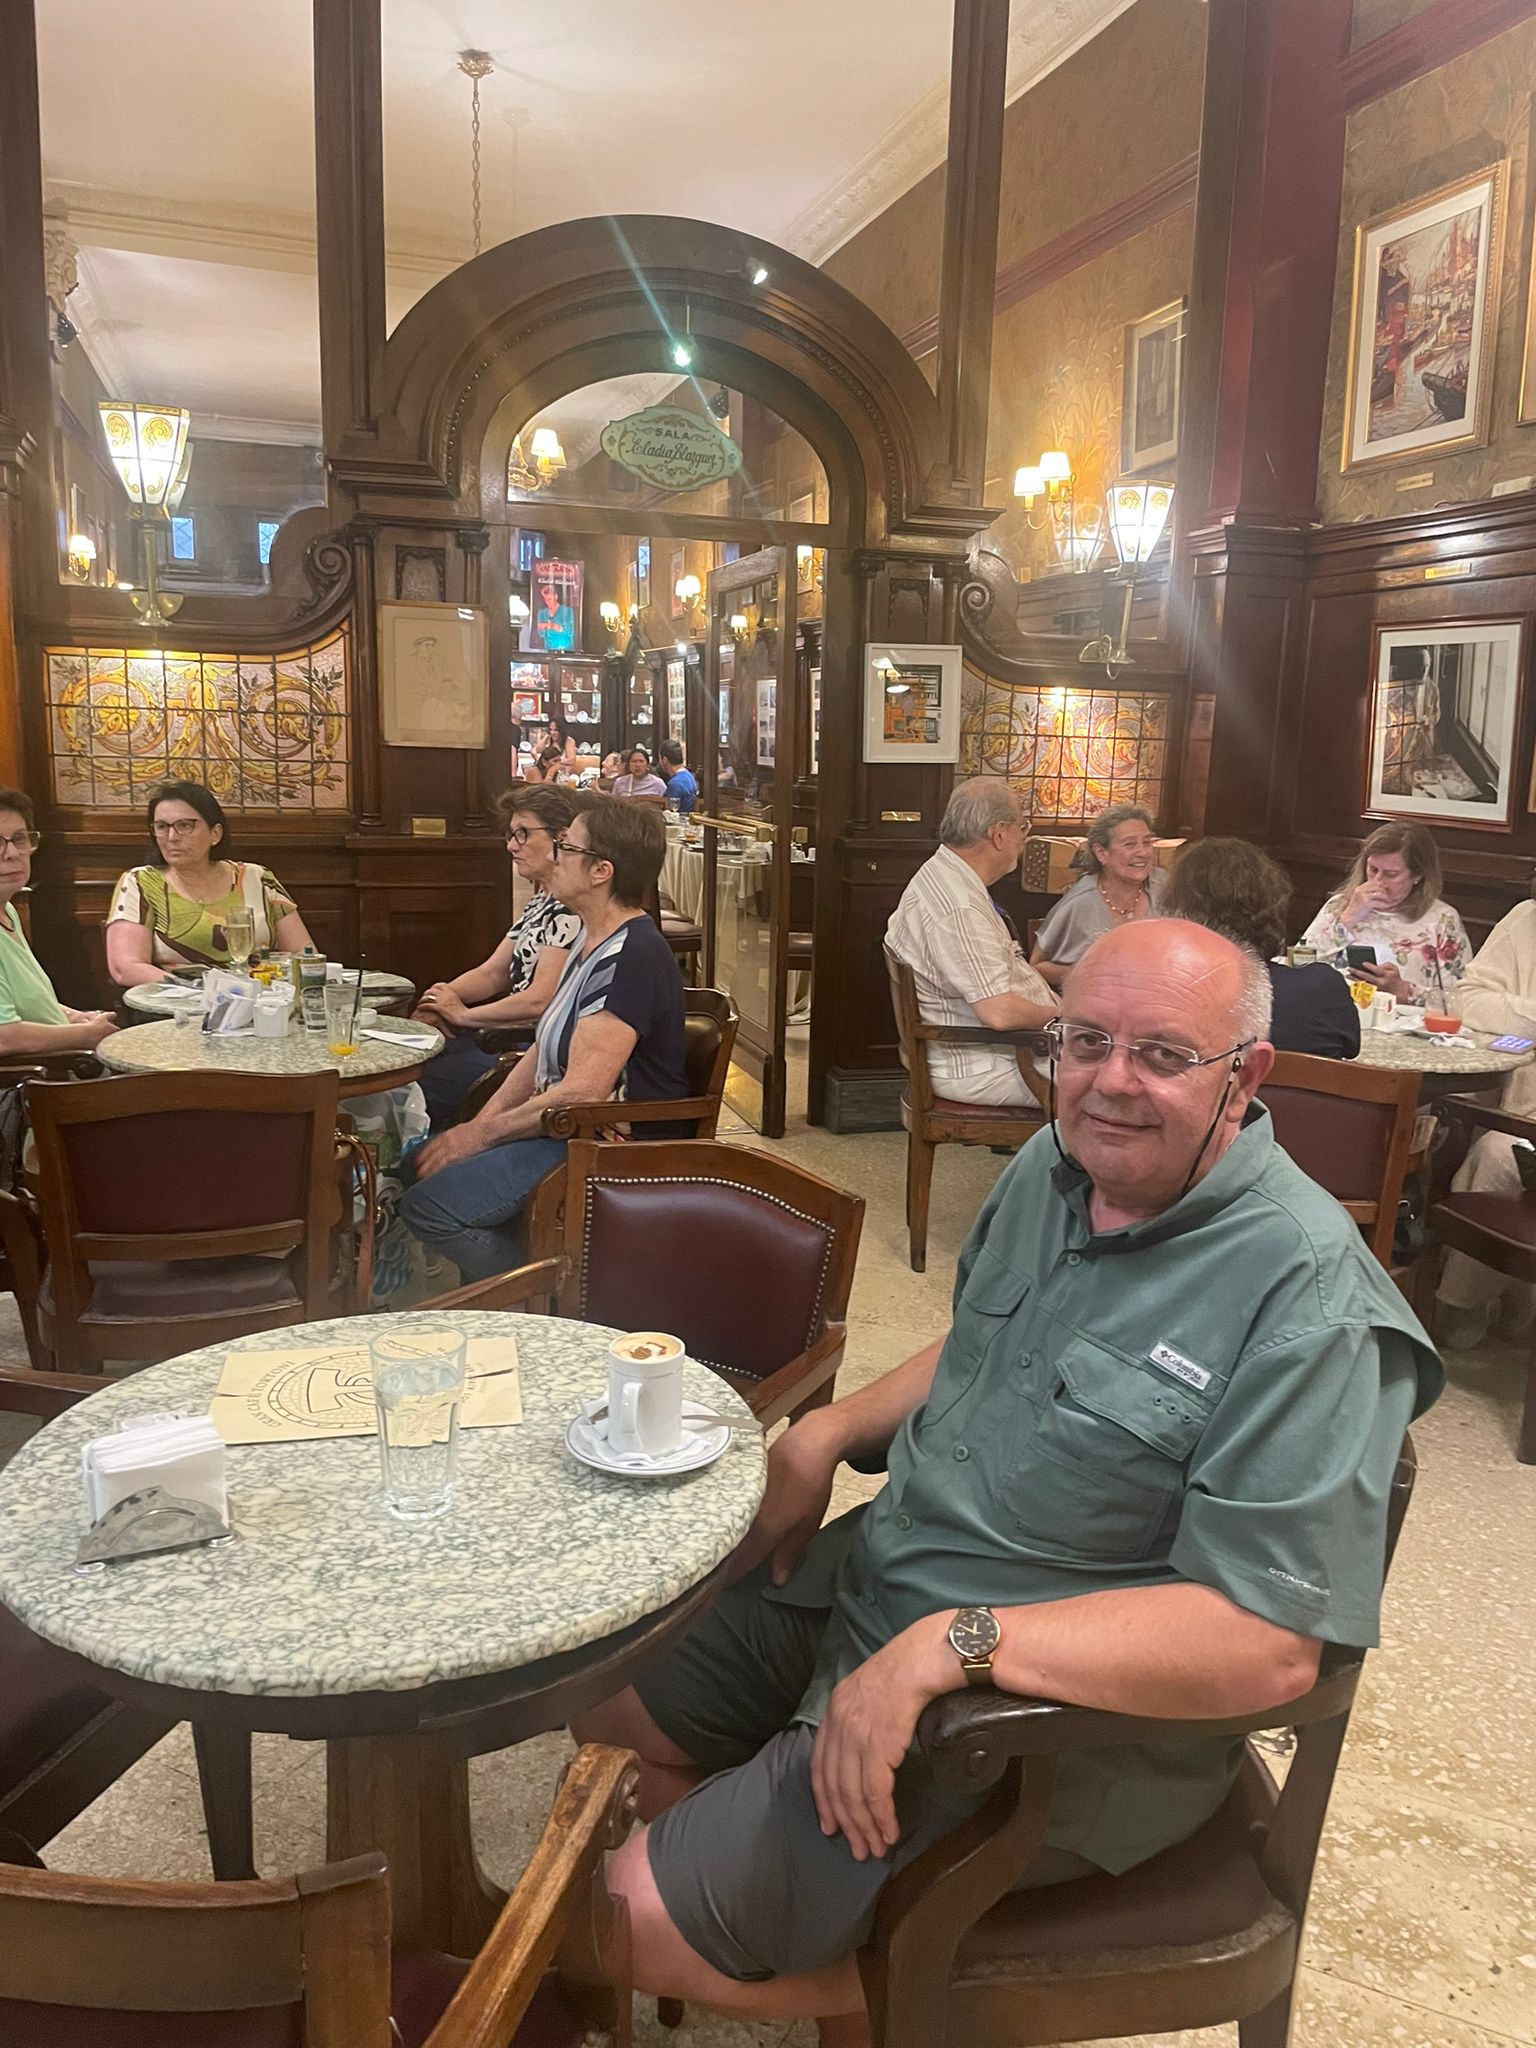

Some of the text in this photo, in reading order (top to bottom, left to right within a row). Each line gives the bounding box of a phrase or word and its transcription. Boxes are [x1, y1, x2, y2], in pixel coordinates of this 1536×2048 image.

[655, 428, 691, 441] SALA
[631, 437, 673, 459] Eladia
[250, 1360, 296, 1391] TORTONI
[1167, 1353, 1202, 1381] Columbia
